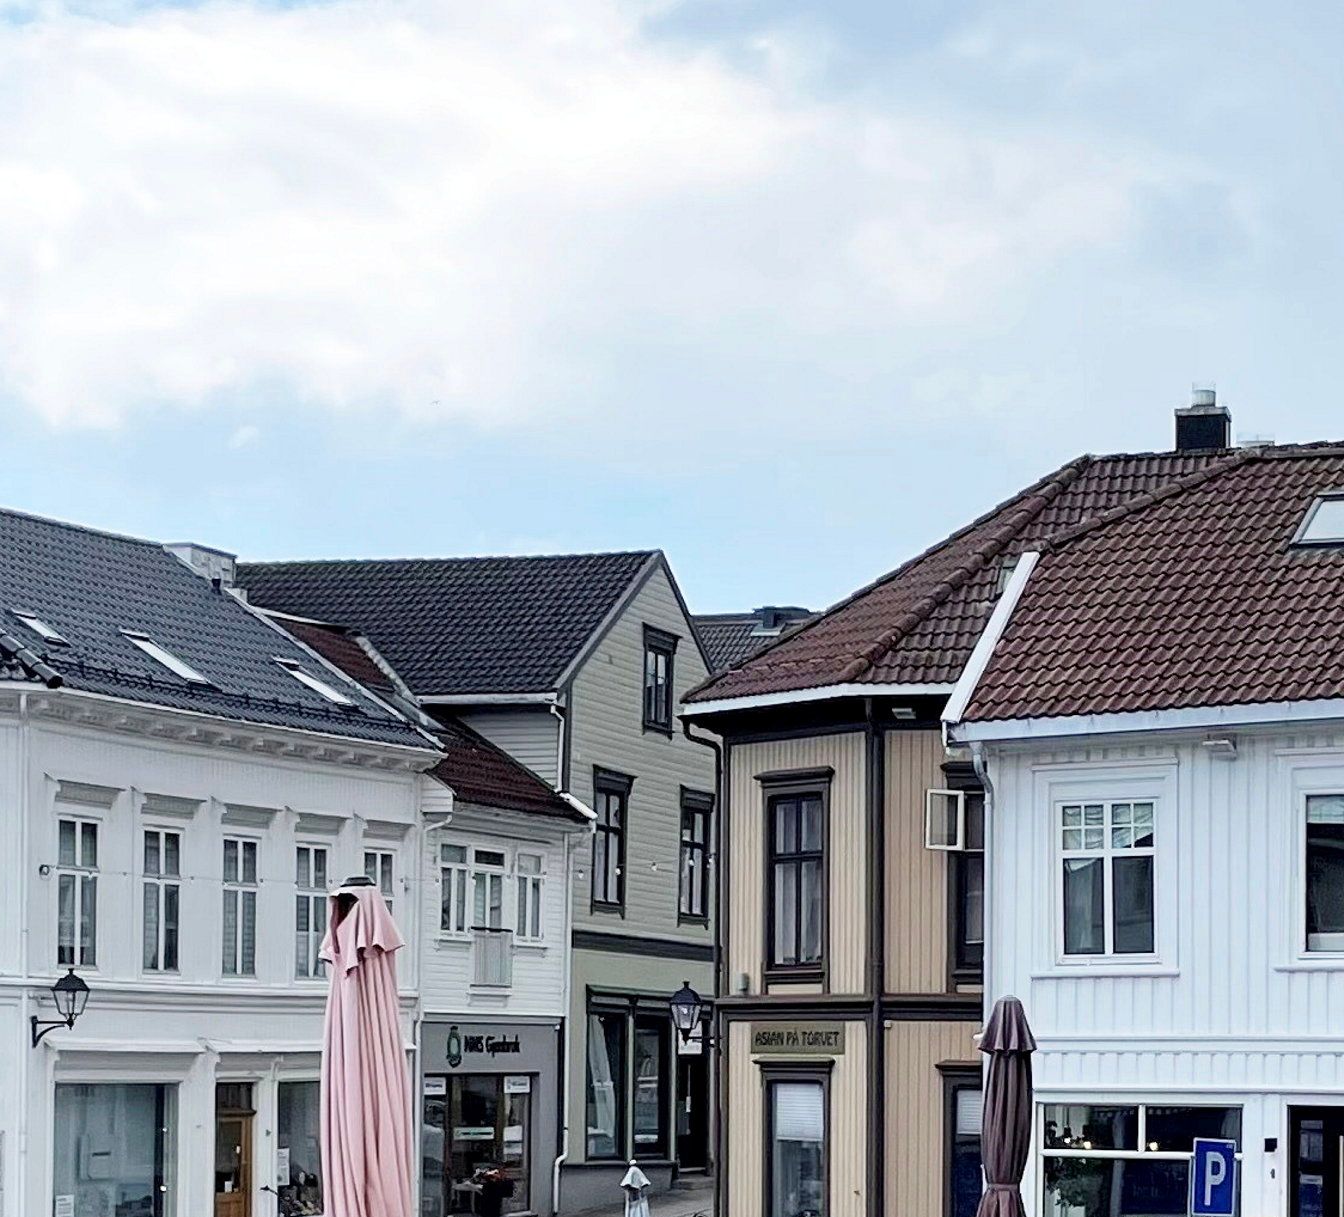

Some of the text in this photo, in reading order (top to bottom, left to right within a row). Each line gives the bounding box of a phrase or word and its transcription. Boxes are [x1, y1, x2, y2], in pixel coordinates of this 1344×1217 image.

[755, 1031, 785, 1047] ASIAN
[801, 1030, 840, 1047] TORVET
[1204, 1151, 1226, 1206] P
